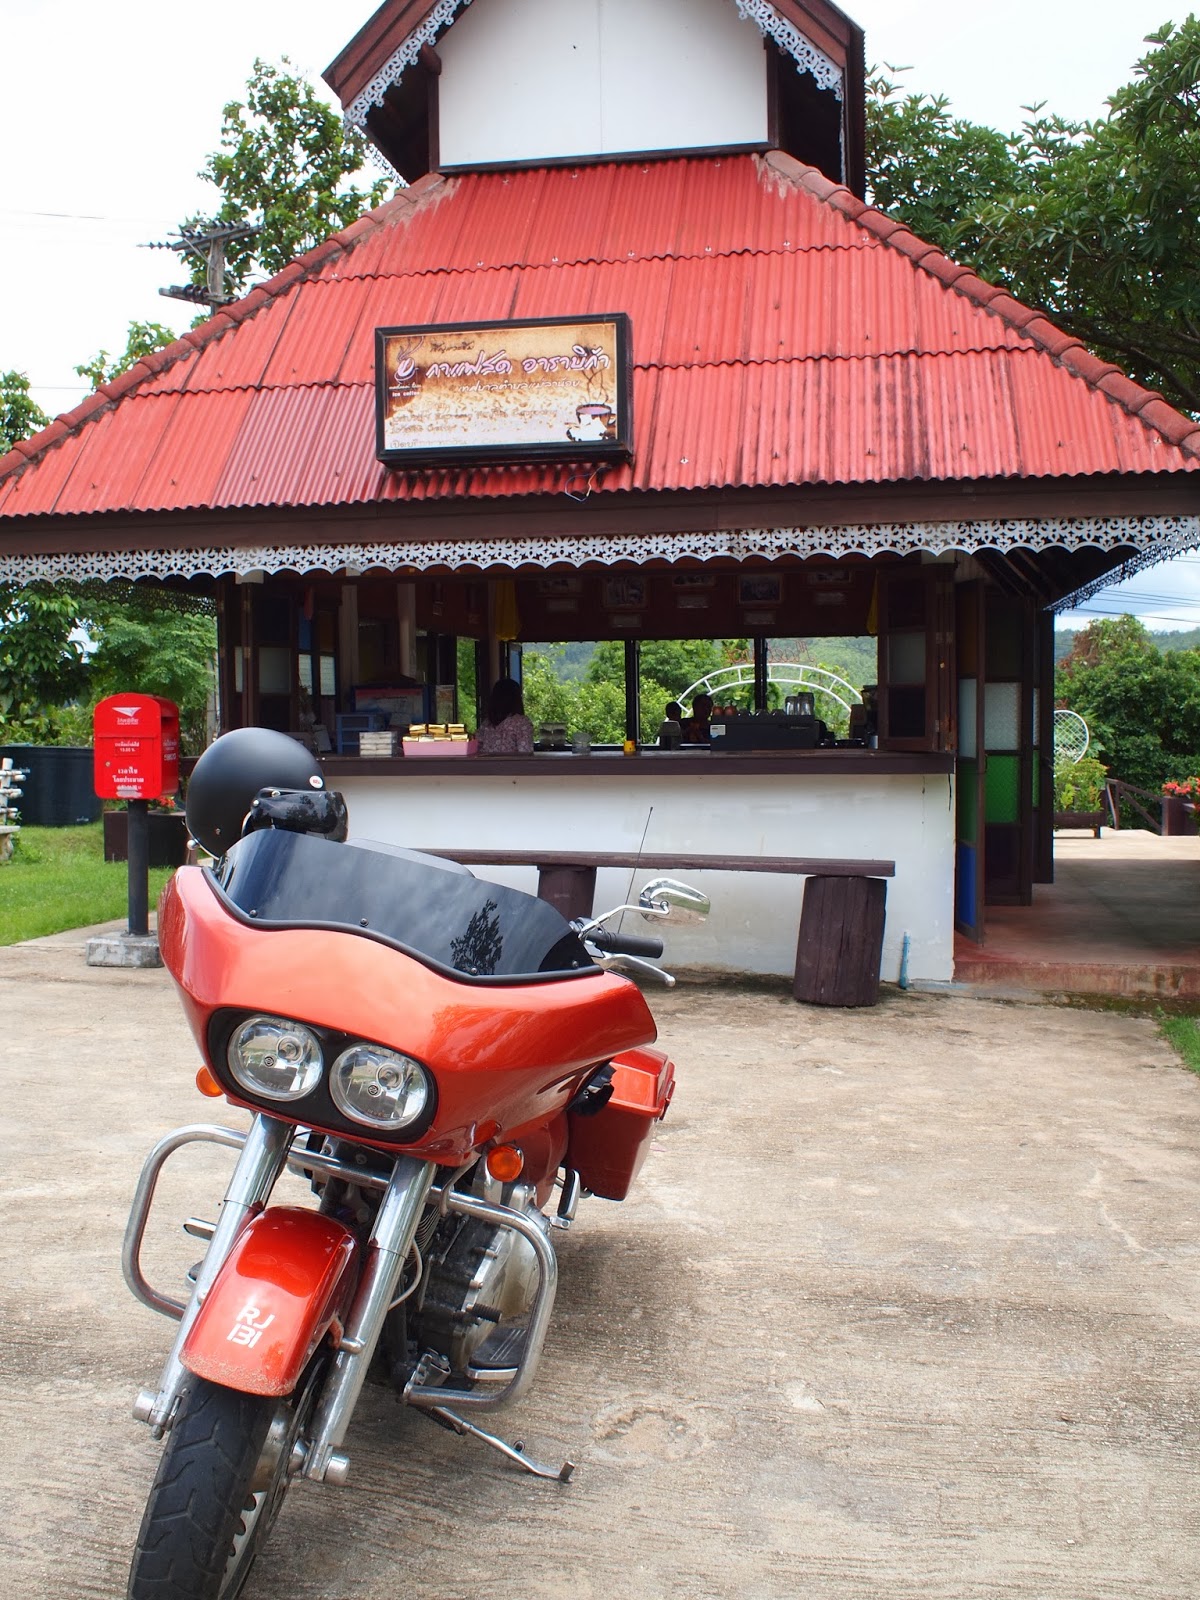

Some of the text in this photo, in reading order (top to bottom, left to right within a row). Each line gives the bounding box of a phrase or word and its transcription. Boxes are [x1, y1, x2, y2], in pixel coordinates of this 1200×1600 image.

[426, 345, 611, 378] กาแฟสด อาราบิก้า
[236, 1306, 275, 1329] RJ
